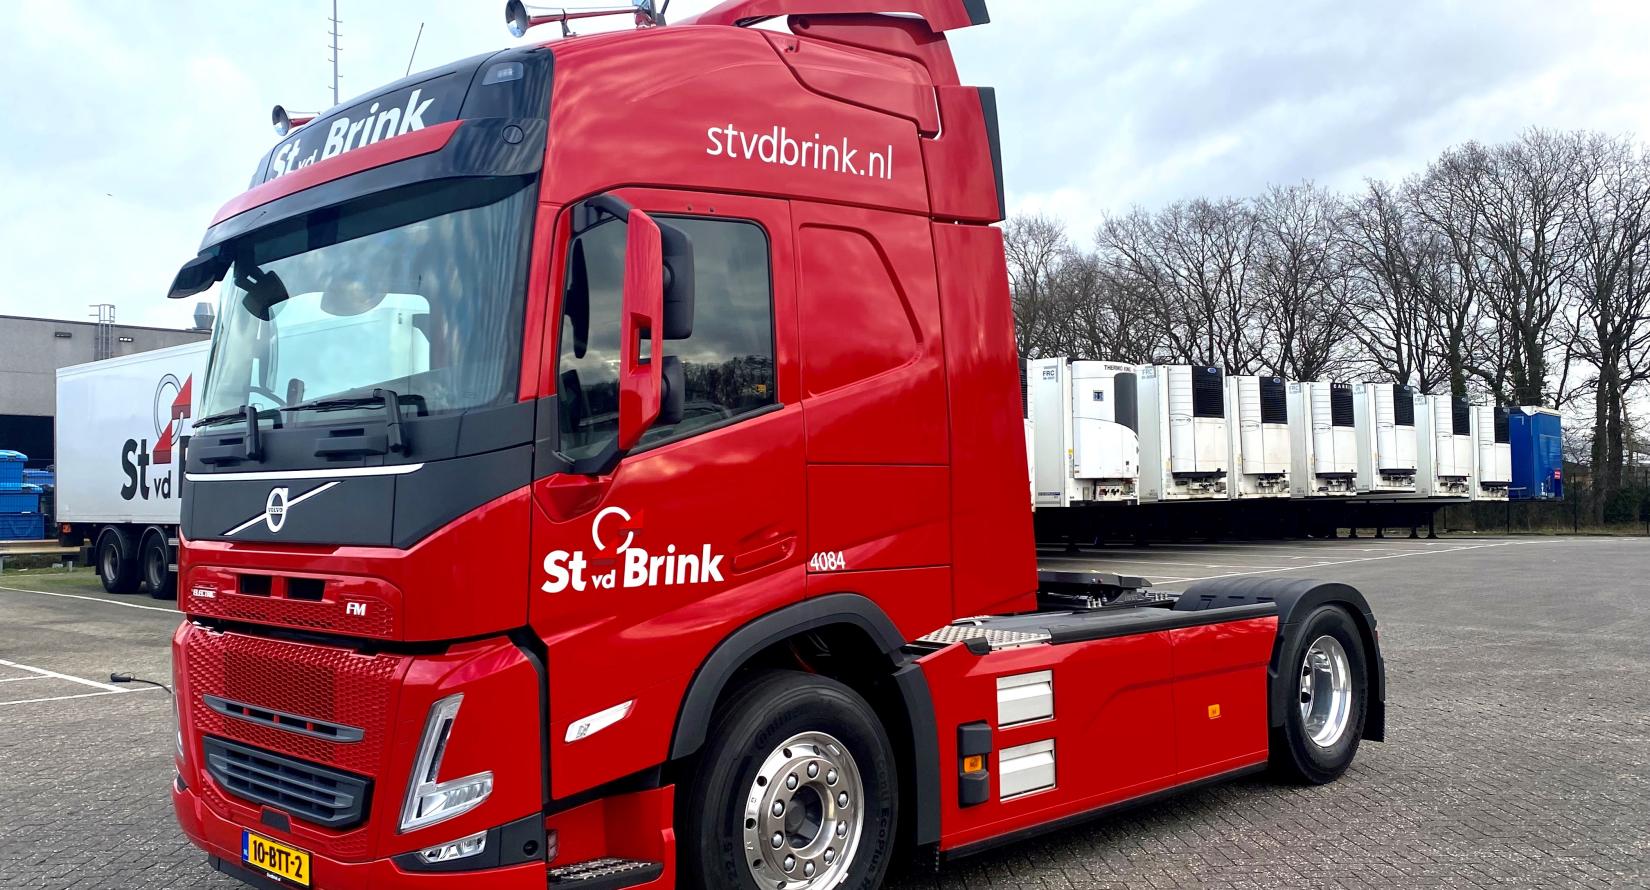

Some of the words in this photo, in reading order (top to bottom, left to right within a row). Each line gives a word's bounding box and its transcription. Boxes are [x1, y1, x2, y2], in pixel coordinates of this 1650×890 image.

[270, 138, 302, 182] St
[320, 88, 435, 161] Brink
[706, 123, 893, 180] stvdbrink.nl
[120, 438, 150, 500] St
[153, 469, 172, 499] vd
[541, 549, 587, 593] St
[591, 565, 616, 590] vd
[623, 543, 725, 589] Brink
[809, 550, 846, 571] 4084
[345, 602, 367, 617] FM
[253, 839, 303, 879] 10-BTT-2
